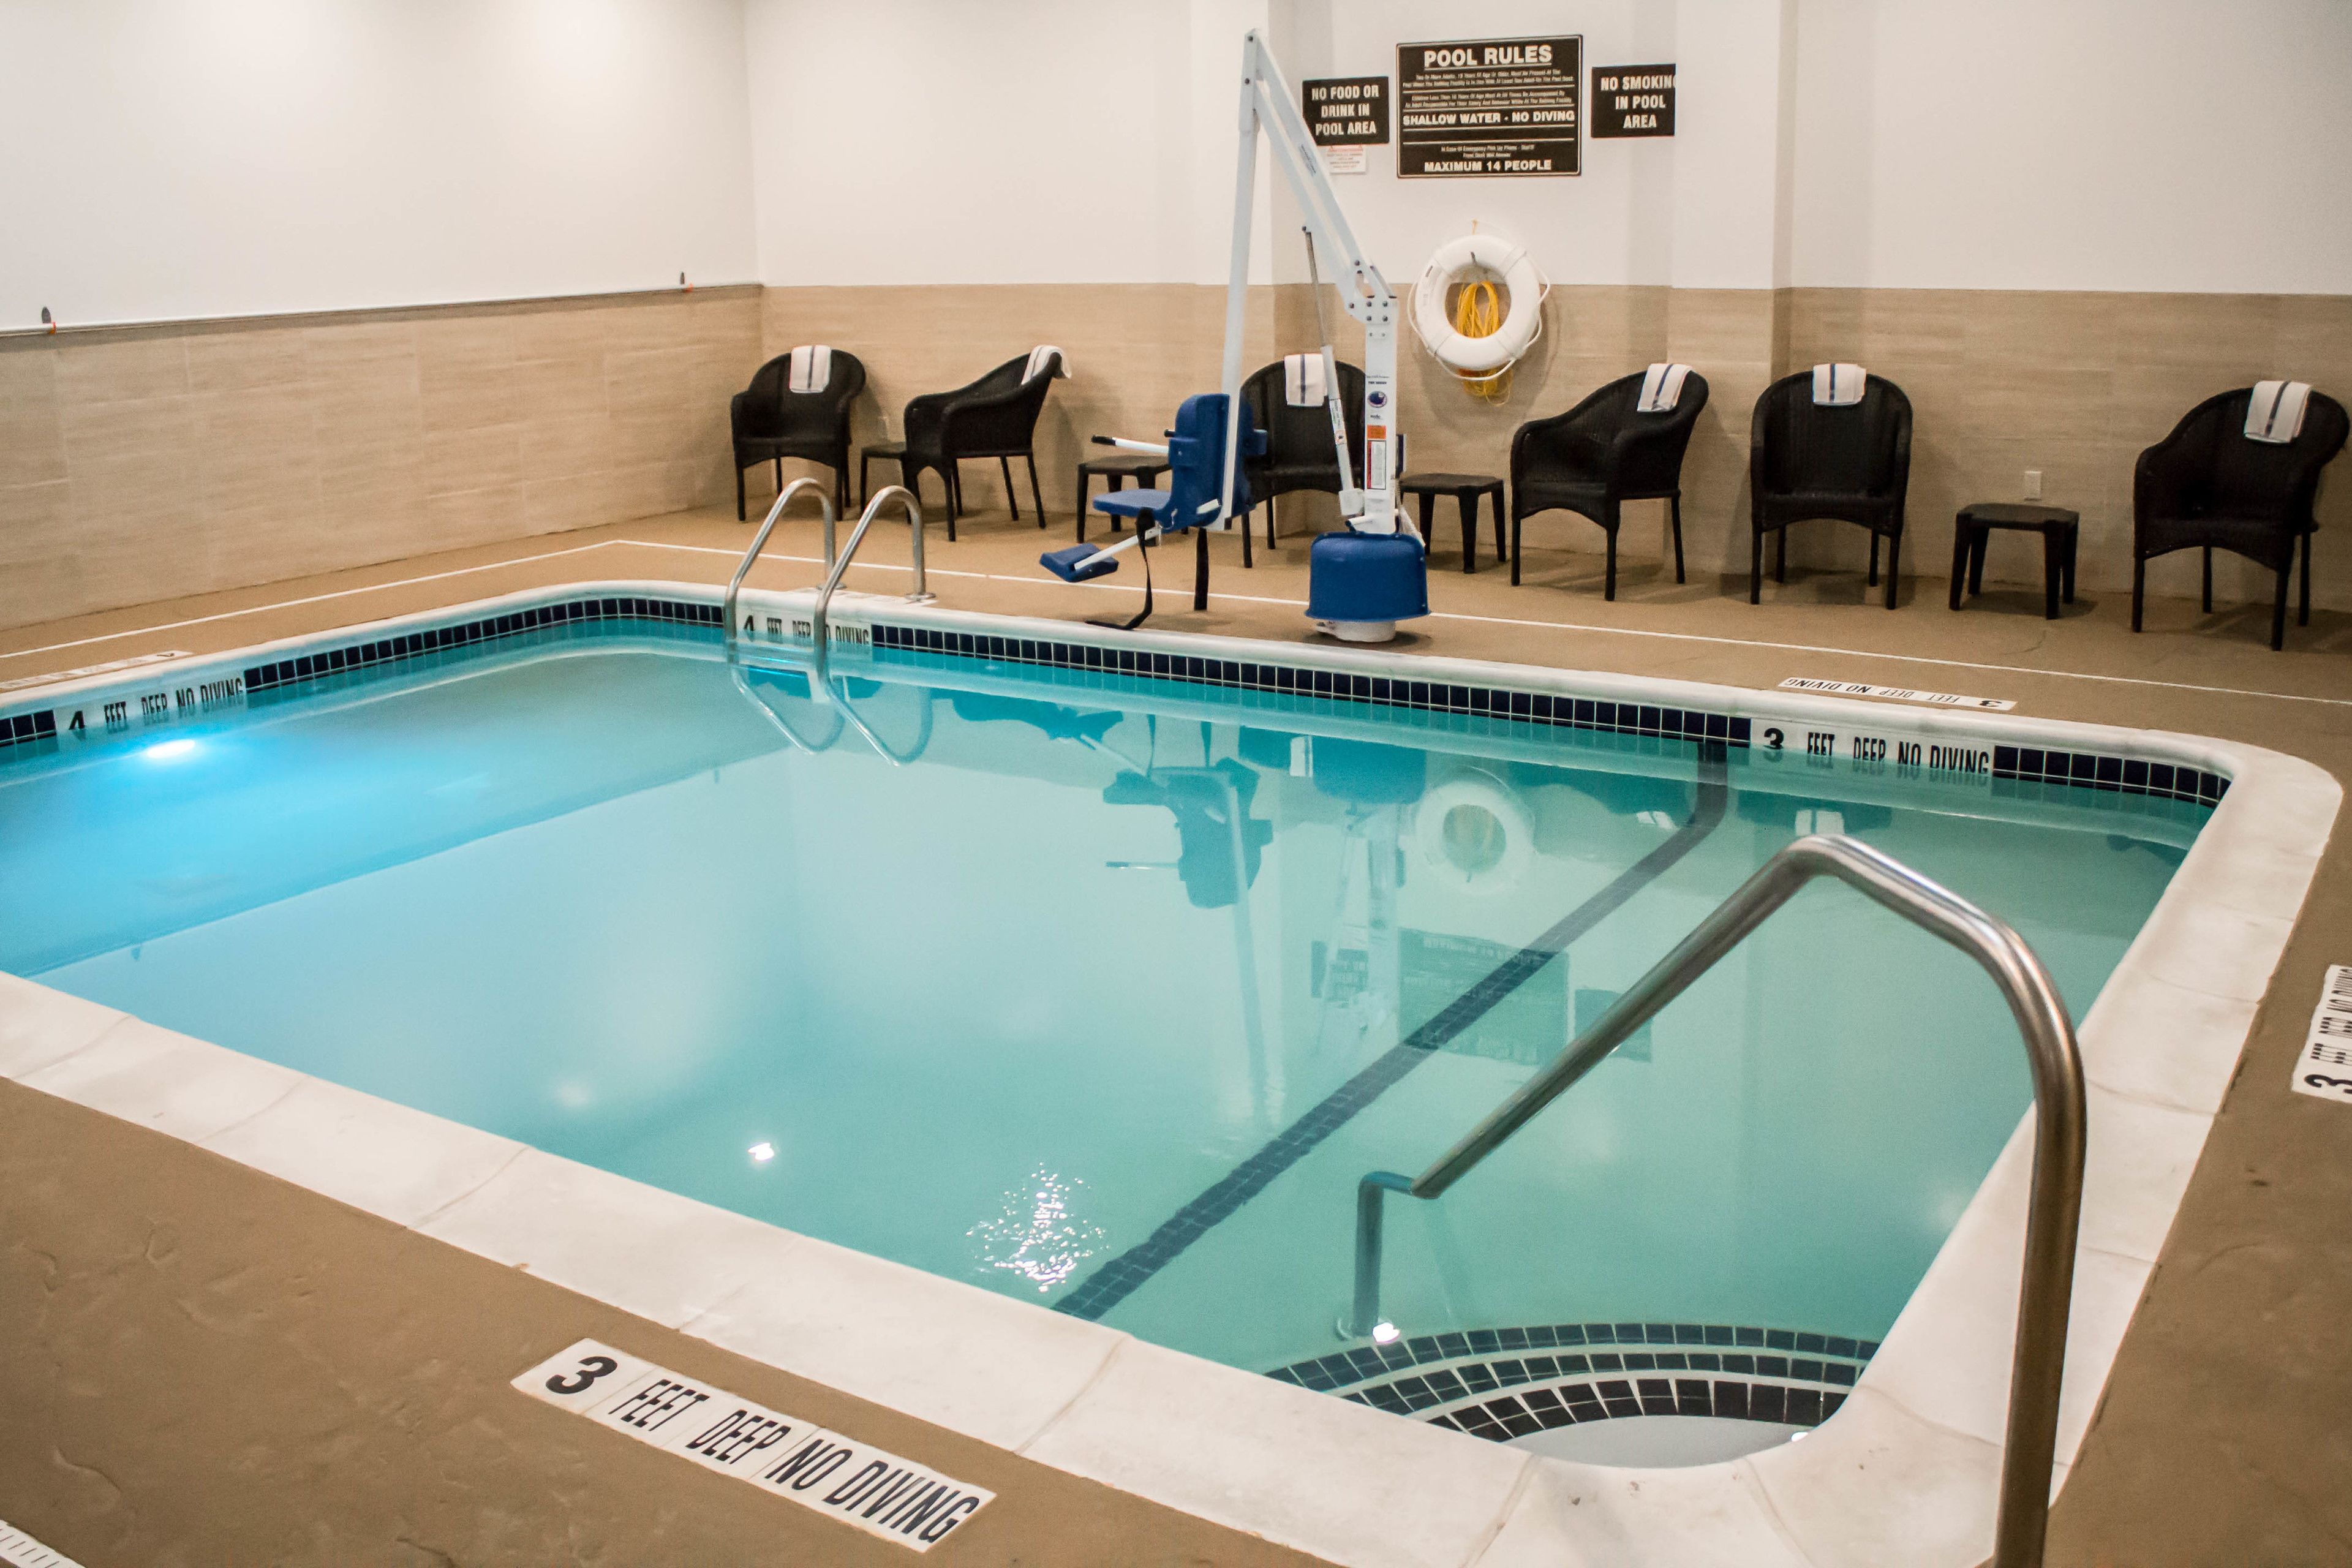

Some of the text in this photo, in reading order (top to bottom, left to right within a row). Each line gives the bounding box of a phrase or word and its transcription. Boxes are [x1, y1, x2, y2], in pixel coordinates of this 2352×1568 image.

[1424, 45, 1552, 67] POOL RULES
[1600, 77, 1618, 91] NO
[1311, 85, 1379, 100] NO FOOD OR
[1615, 95, 1666, 110] IN POOL
[1321, 103, 1370, 118] DRINK IN
[1403, 114, 1457, 126] SHALLOW
[1460, 113, 1501, 124] WATER
[1512, 111, 1529, 123] NO
[1533, 110, 1575, 122] DIVING
[1316, 121, 1376, 135] POOL AREA
[1623, 114, 1657, 129] AREA
[1424, 159, 1551, 172] MAXIMUM 14 PEOPLE
[767, 617, 782, 634] FEET
[793, 620, 811, 637] DEEP
[835, 625, 869, 644] DIVING
[1788, 679, 1842, 690] DIVING
[1845, 685, 1872, 693] NO
[1879, 689, 1915, 698] DEEP
[1926, 694, 1960, 703] FEET
[69, 677, 243, 729] 4 FEET DEEP NO DIVING
[1763, 728, 1989, 774] 3 FEET DEEP NO DIVING
[2304, 1074, 2352, 1095] 3
[546, 1356, 979, 1544] 3 FEET DEEP NO DIVING
